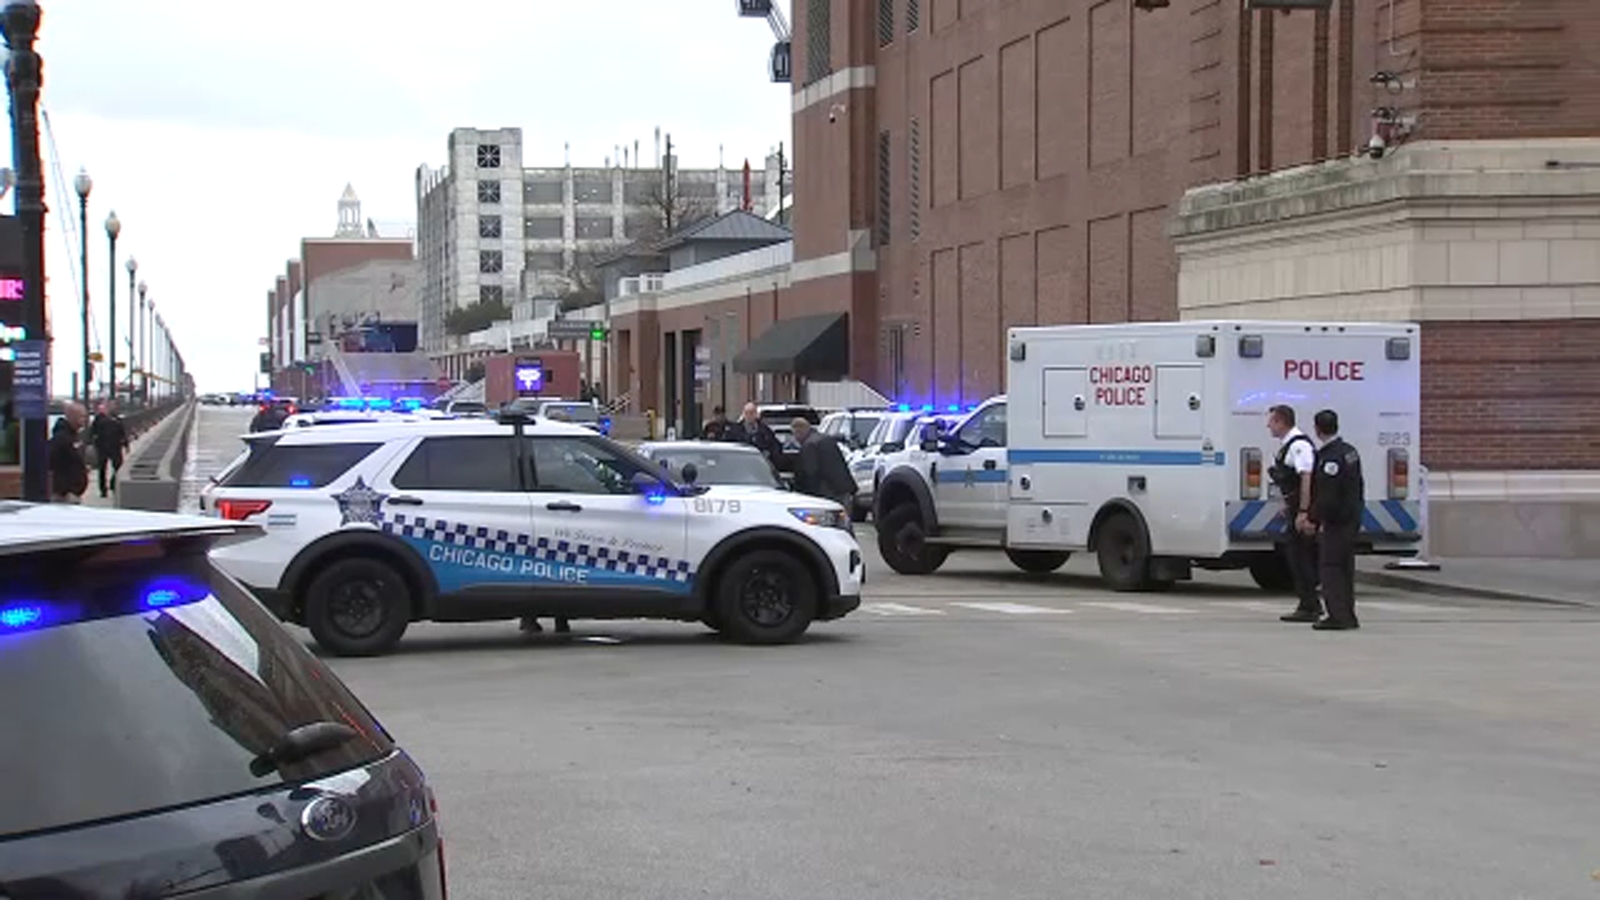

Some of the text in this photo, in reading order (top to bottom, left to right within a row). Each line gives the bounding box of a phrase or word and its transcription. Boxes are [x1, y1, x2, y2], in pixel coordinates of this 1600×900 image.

[1089, 366, 1152, 383] CHICAGO
[1284, 360, 1364, 380] POLICE
[1095, 387, 1145, 405] POLICE
[429, 544, 590, 583] CHICAGO POLICE
